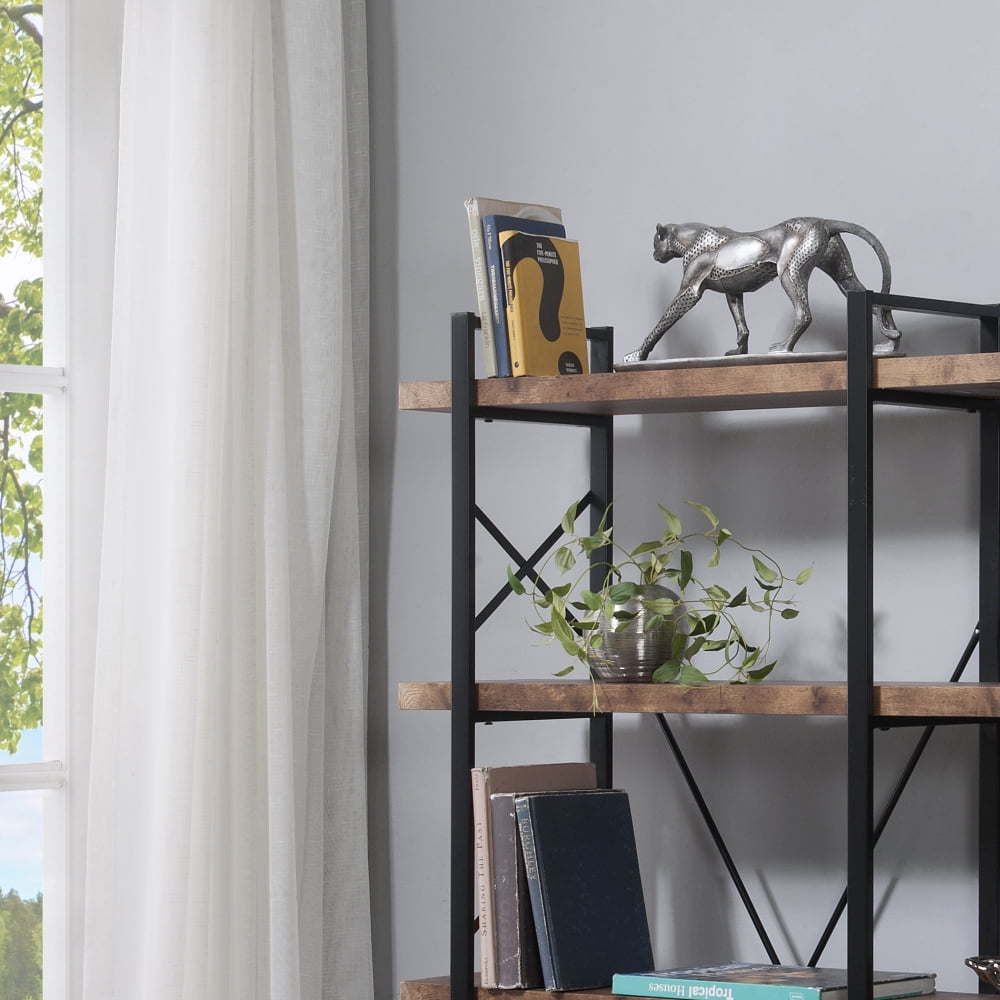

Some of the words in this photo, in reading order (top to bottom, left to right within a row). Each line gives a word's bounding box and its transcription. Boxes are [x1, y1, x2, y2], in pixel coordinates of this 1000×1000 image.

[519, 818, 538, 880] BURGHLEY
[477, 855, 485, 877] THE
[479, 884, 488, 936] SHARING
[649, 983, 685, 996] Houses
[689, 985, 734, 1000] Tropical
